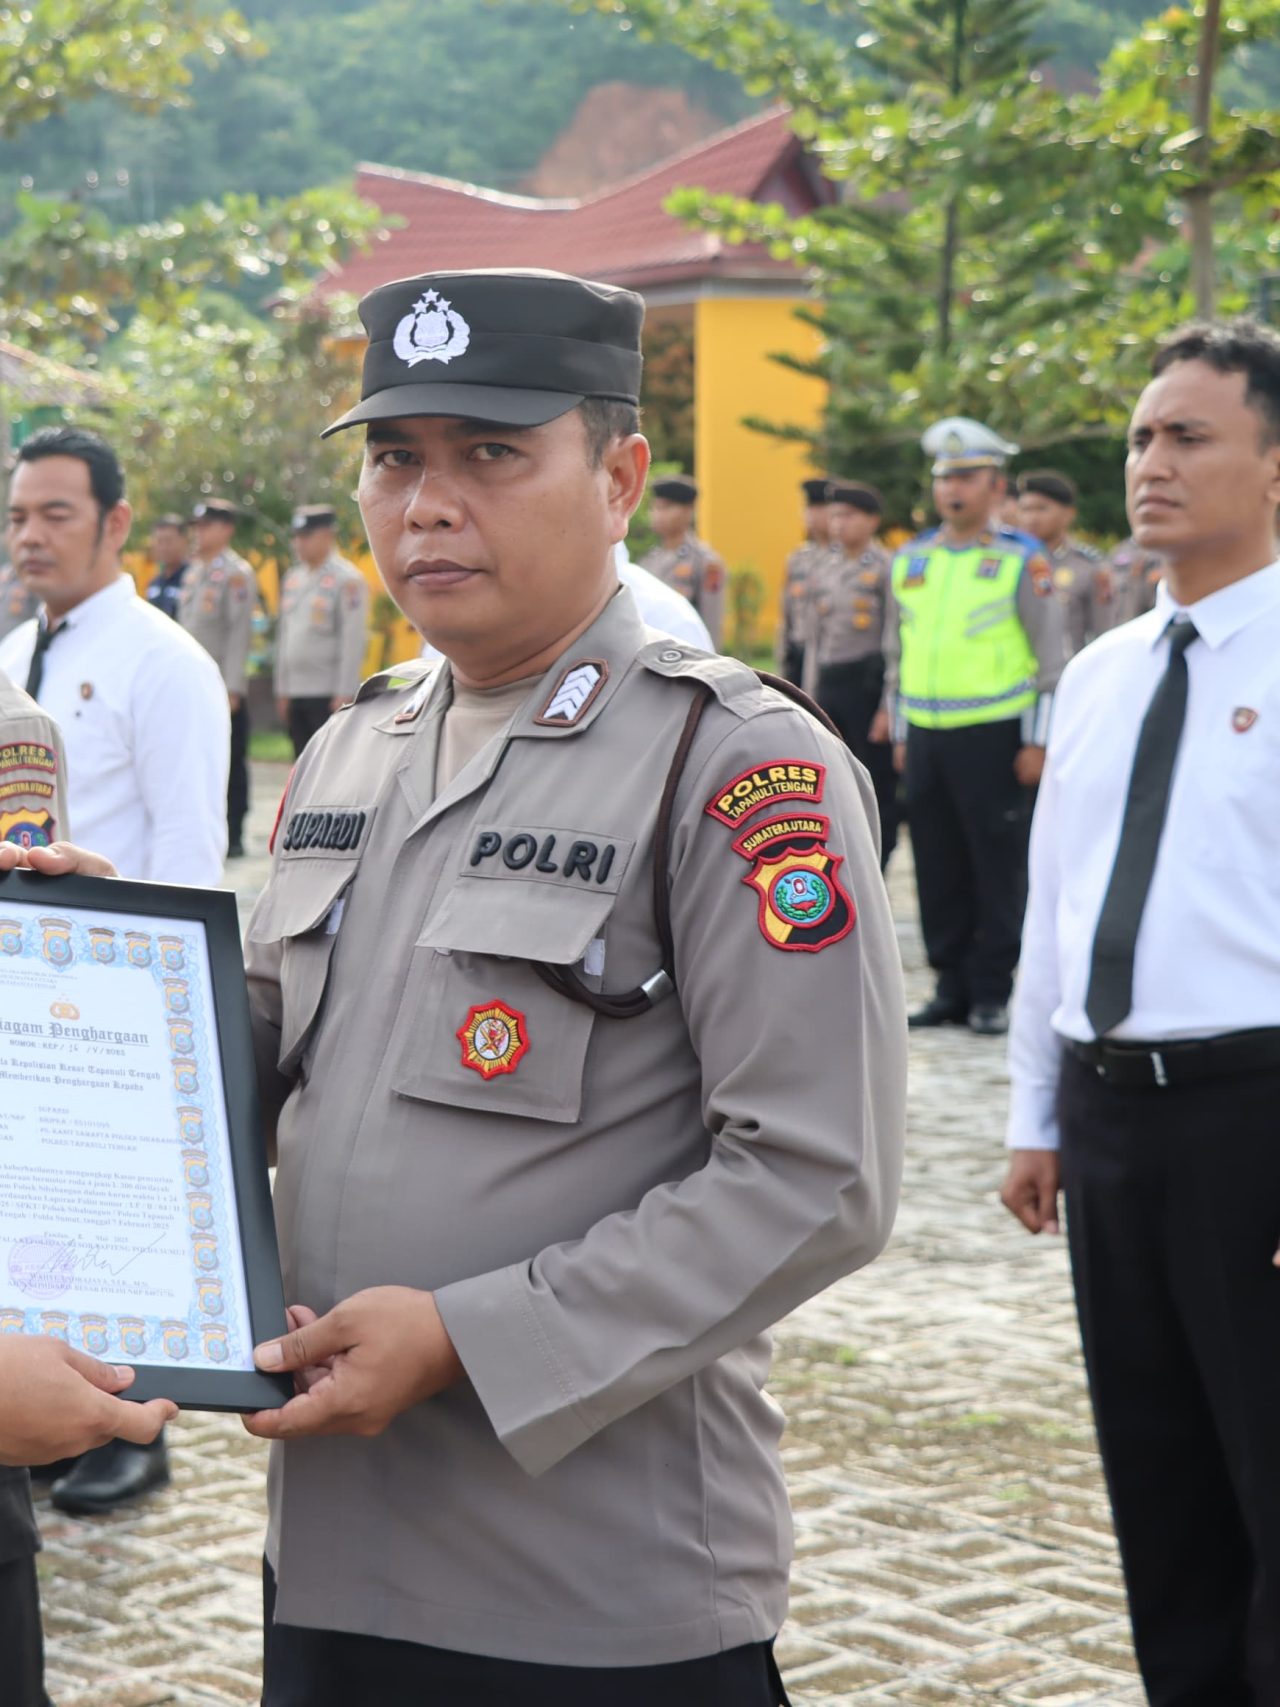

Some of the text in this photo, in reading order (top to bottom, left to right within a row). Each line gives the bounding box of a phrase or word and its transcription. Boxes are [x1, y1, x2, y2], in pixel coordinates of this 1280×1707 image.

[717, 766, 817, 812] POLRES
[728, 781, 814, 818] TAPANULI TENGAH
[283, 810, 366, 851] SUPARDI
[743, 821, 822, 851] SUMATERA UTARA
[470, 831, 615, 884] POLRI
[10, 1039, 37, 1048] NOMOR
[49, 1022, 149, 1044] Penghargaan
[11, 1058, 57, 1070] Kepolisian
[54, 1075, 110, 1089] Penghargaan
